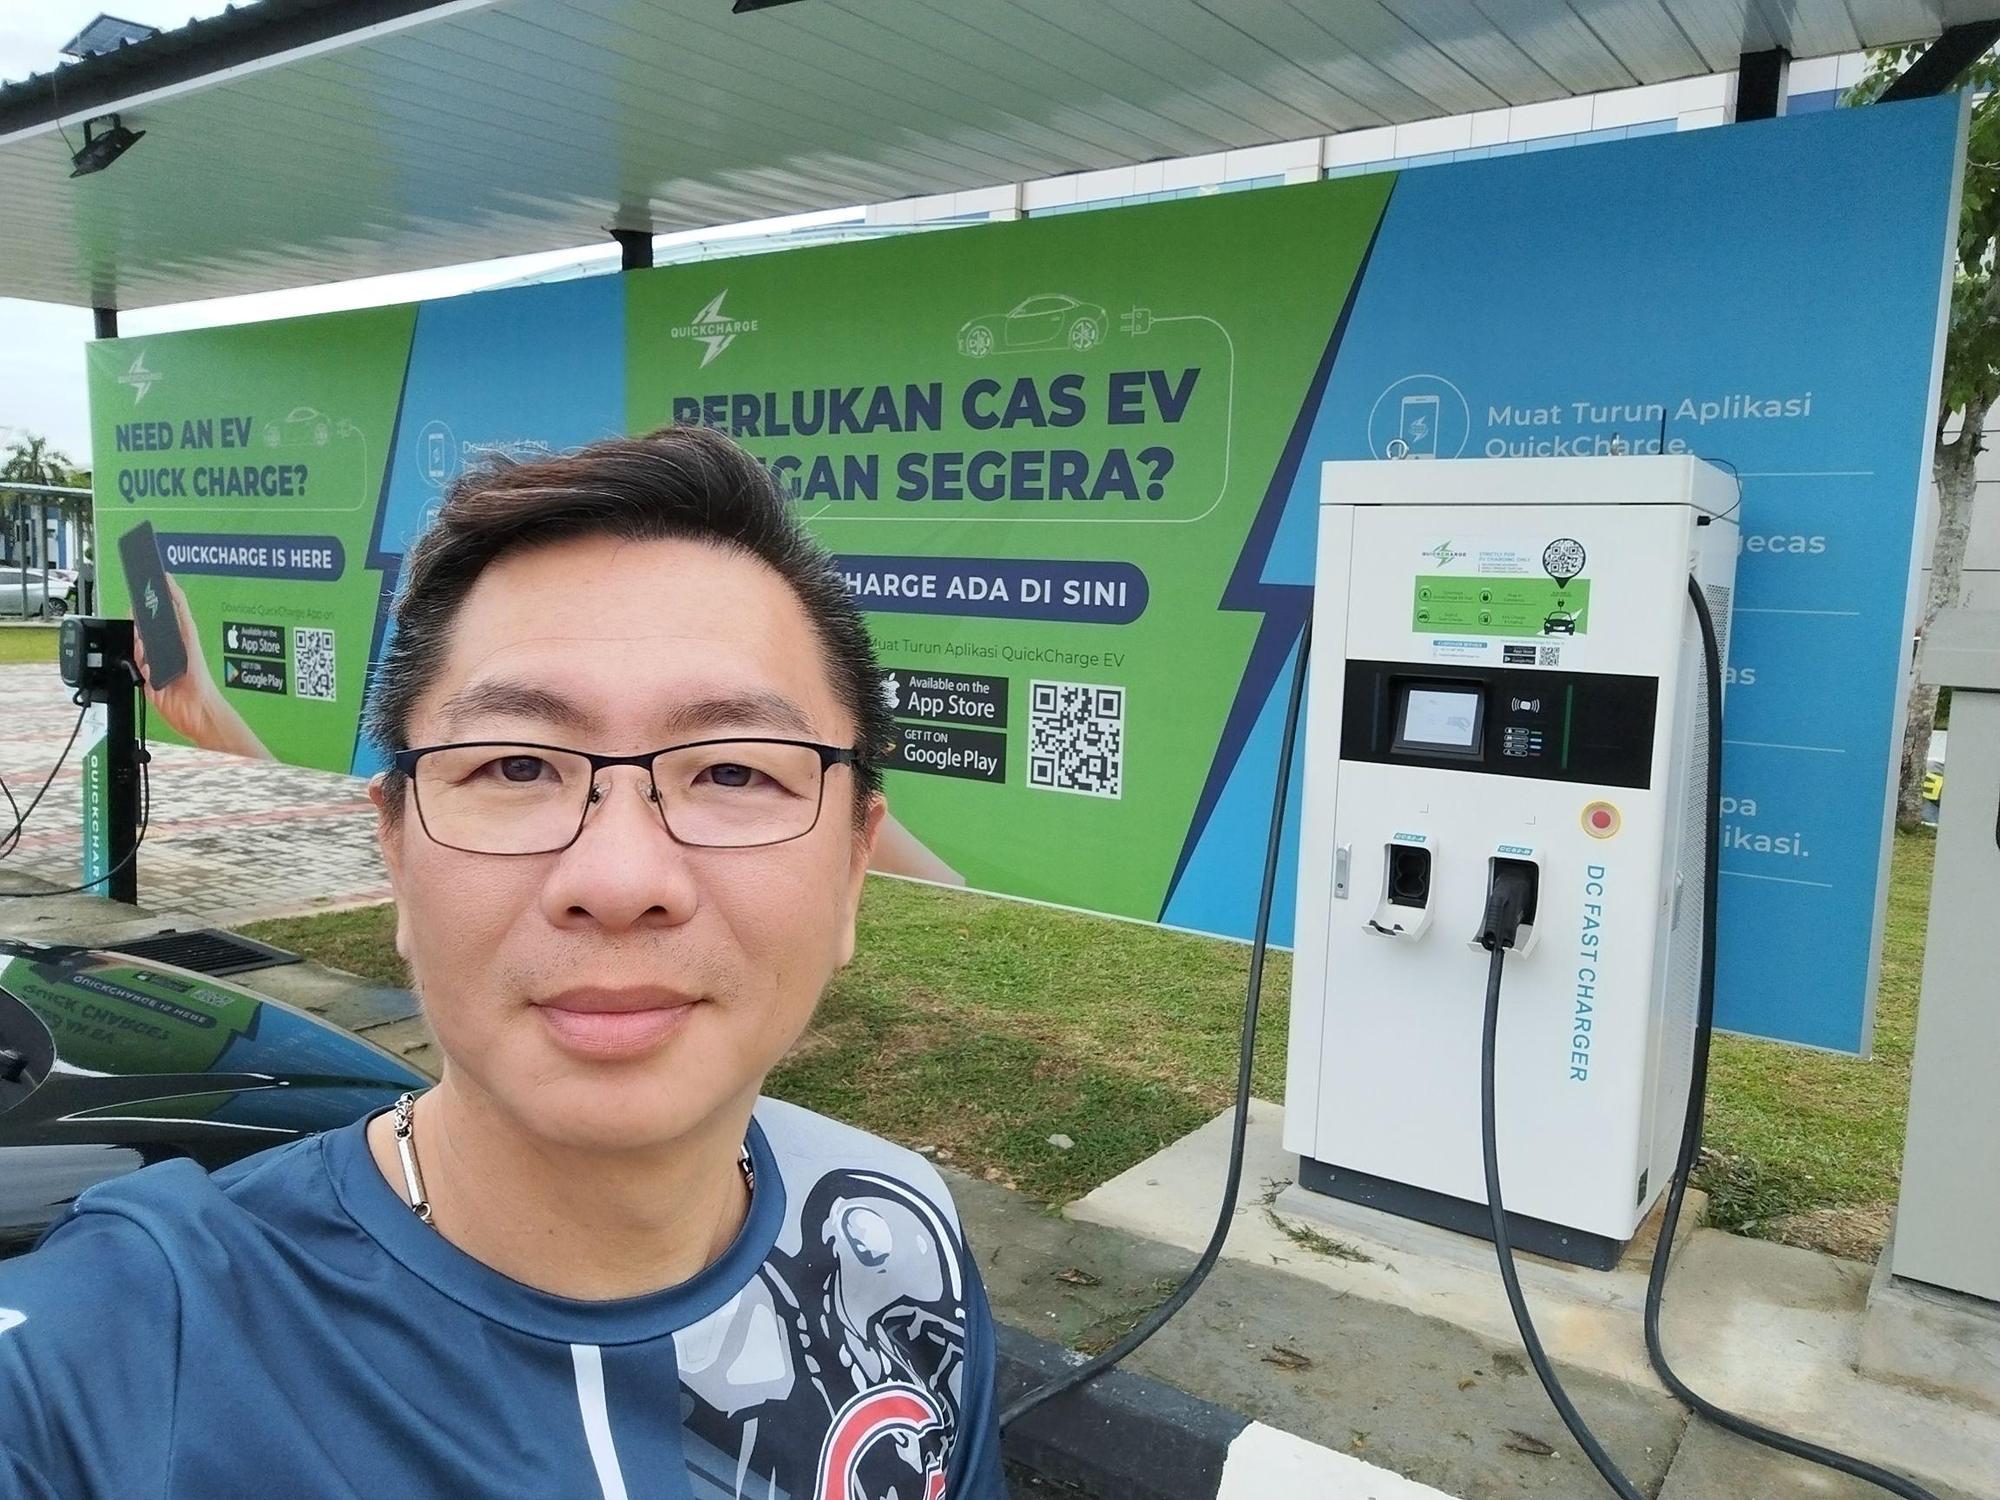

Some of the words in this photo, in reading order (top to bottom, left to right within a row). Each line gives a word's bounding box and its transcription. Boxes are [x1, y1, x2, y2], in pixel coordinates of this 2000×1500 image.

[671, 320, 758, 338] QUICKCHARGE
[672, 382, 943, 438] PERLUKAN
[962, 373, 1086, 430] CAS
[1107, 368, 1201, 425] EV
[1487, 405, 1561, 427] Muat
[1571, 402, 1664, 425] Turun
[1674, 392, 1812, 426] Aplikasi
[116, 421, 174, 451] NEED
[180, 419, 213, 450] AN
[220, 416, 252, 448] EV
[118, 467, 187, 504] QUICK
[192, 464, 308, 497] CHARGE?
[760, 455, 879, 501] GAN
[896, 447, 1175, 502] SEGERA?
[167, 544, 268, 567] QUICKCHARGE
[272, 549, 286, 567] IS
[291, 549, 332, 569] HERE
[1738, 535, 1826, 555] ecas
[838, 570, 937, 599] HARGE
[946, 576, 1009, 601] ADA
[1021, 579, 1051, 604] DI
[1063, 581, 1127, 607] SINI
[241, 638, 258, 653] App
[260, 639, 280, 654] Store
[904, 639, 941, 655] Turun
[944, 641, 998, 660] Aplikasi
[1003, 646, 1099, 669] QuickCharge
[1104, 652, 1125, 667] EV
[241, 672, 267, 688] Google
[268, 674, 283, 690] Play
[909, 676, 955, 691] Available
[956, 684, 970, 693] on
[972, 682, 990, 694] the
[908, 692, 944, 717] App
[948, 695, 995, 718] Store
[904, 729, 922, 741] GET
[924, 730, 932, 741] IT
[933, 732, 948, 743] ON
[904, 744, 962, 770] Google
[964, 750, 998, 776] Play
[1724, 825, 1810, 857] ikasi.
[1585, 864, 1605, 897] DC
[1581, 903, 1601, 962] FAST
[1570, 968, 1596, 1082] CHARGER
